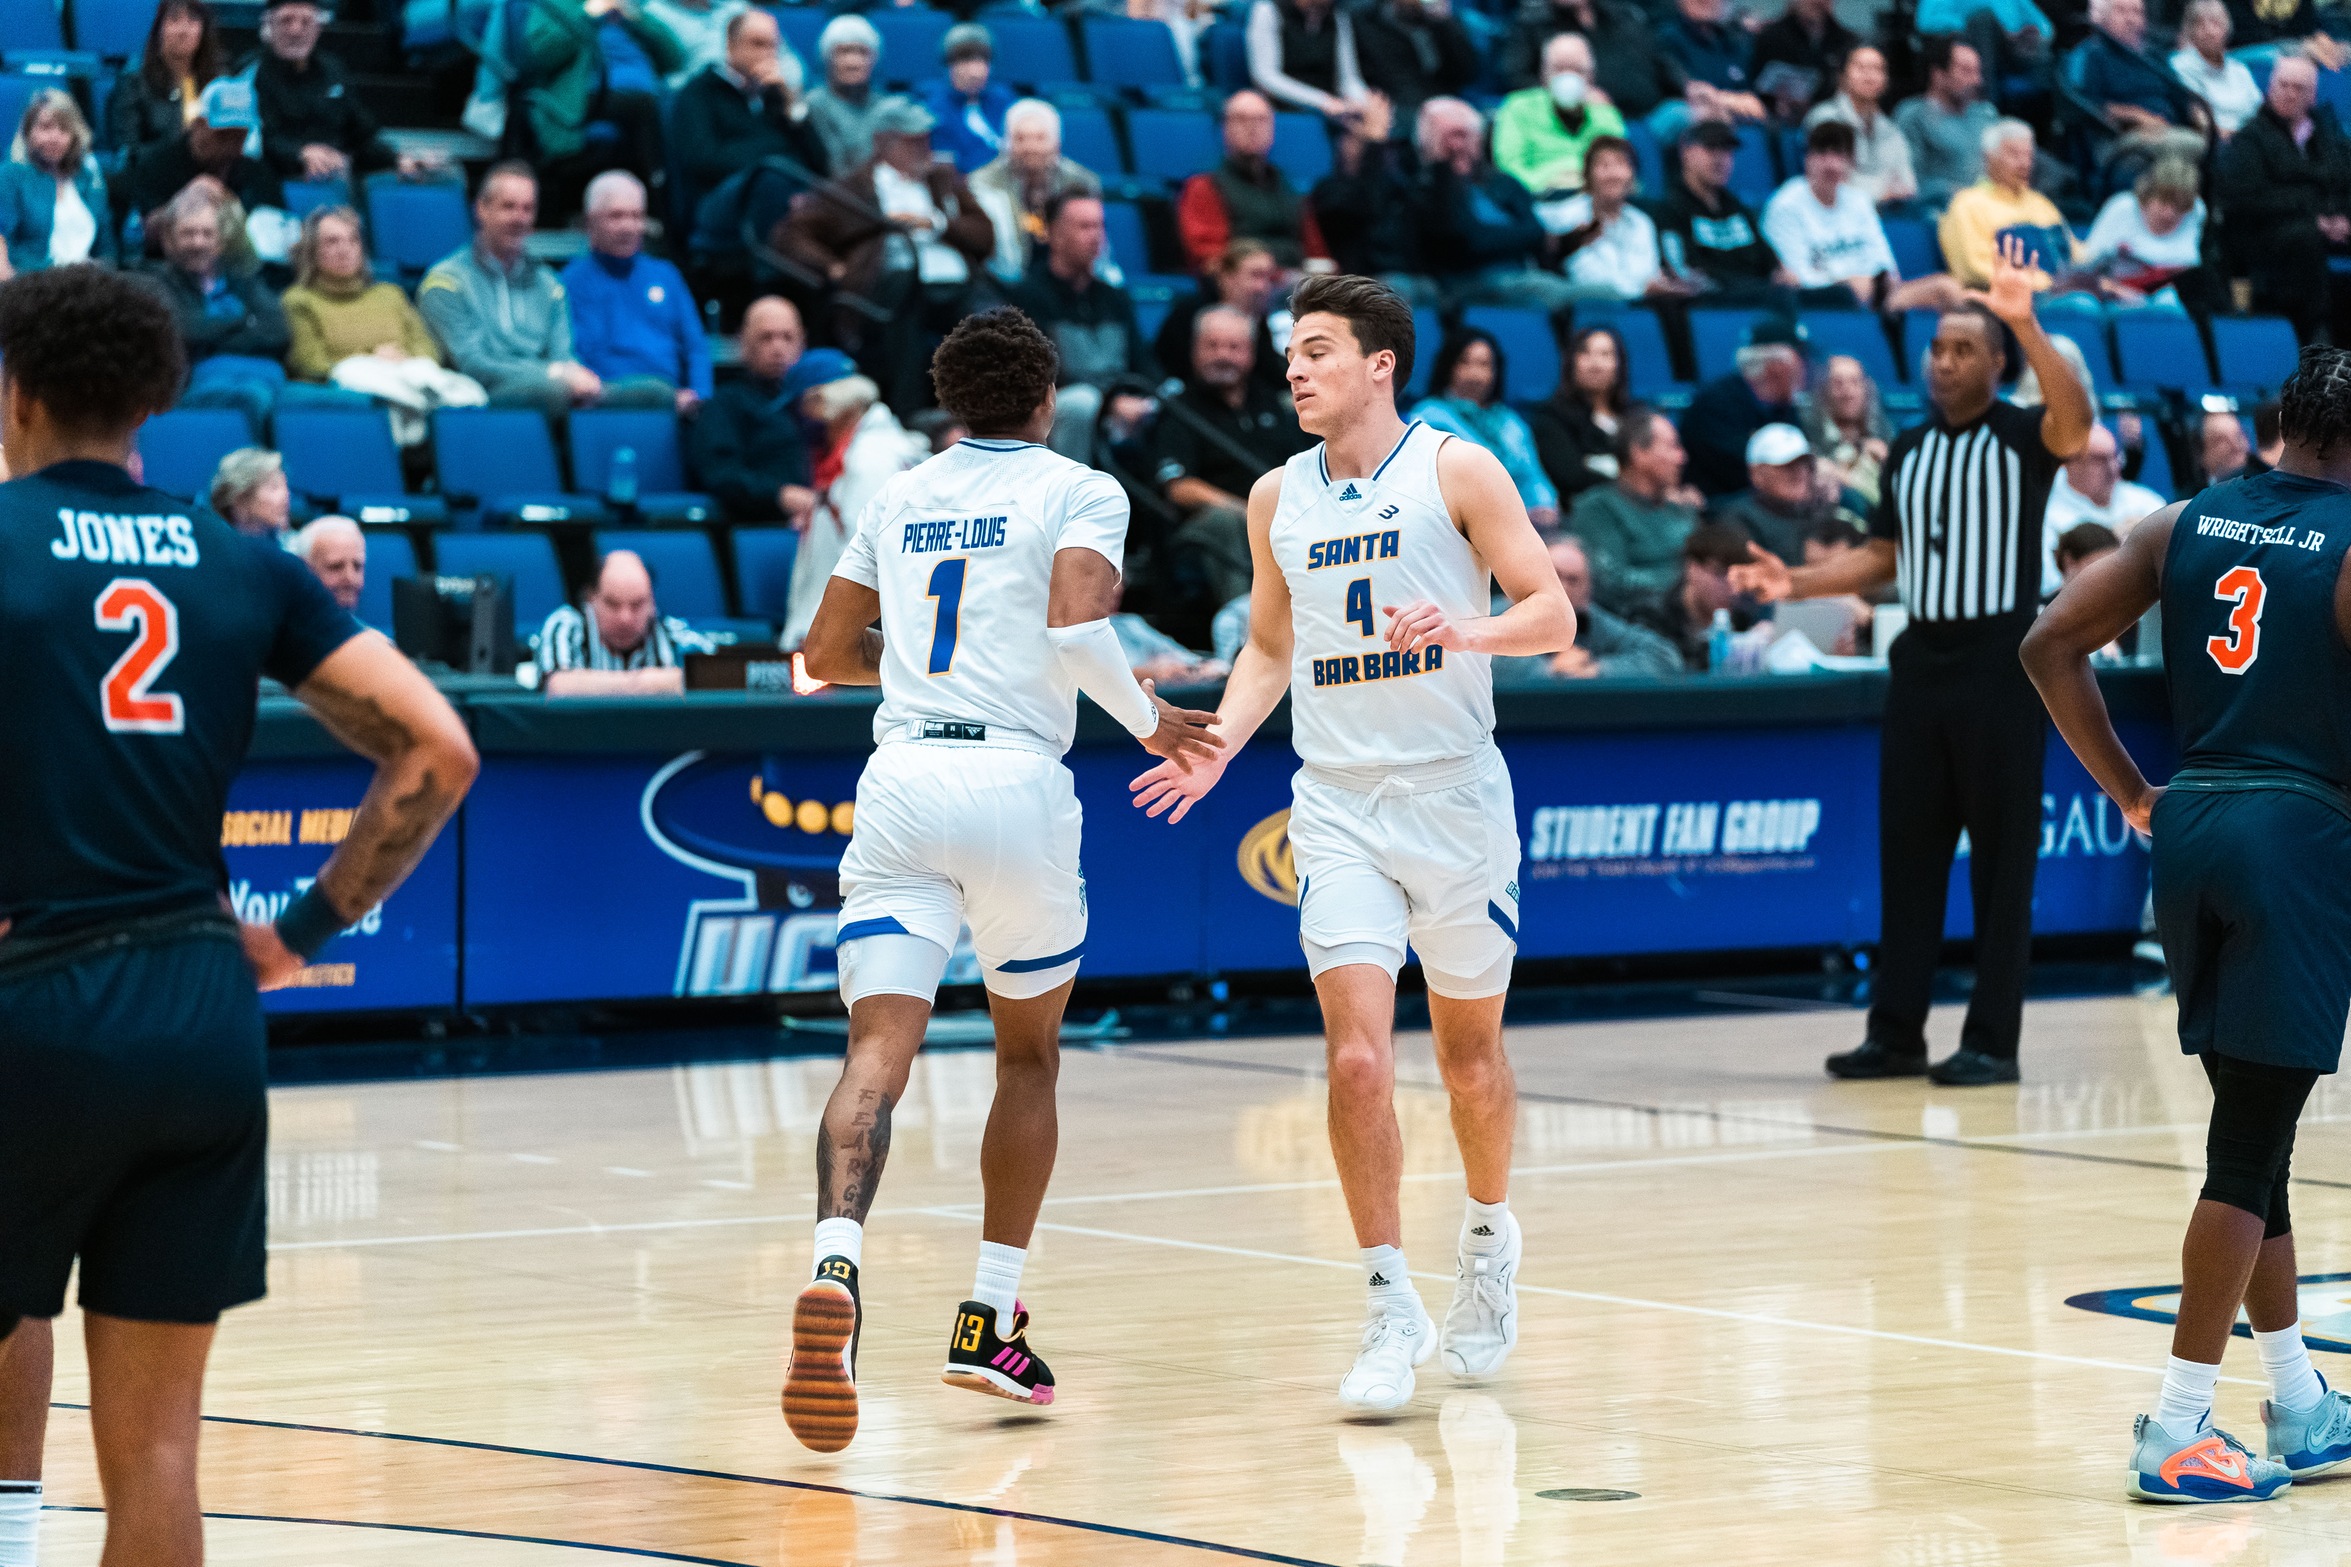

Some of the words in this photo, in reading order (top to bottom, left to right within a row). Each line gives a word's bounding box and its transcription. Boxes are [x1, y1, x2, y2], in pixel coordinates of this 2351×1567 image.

[51, 507, 199, 568] JONES
[902, 516, 1008, 554] PIERRE-LOUIS
[1307, 529, 1400, 572] SANTA
[2298, 530, 2325, 552] JR
[925, 555, 970, 678] 1
[1344, 576, 1377, 639] 4
[2206, 565, 2267, 675] 3
[94, 577, 185, 735] 2
[1313, 643, 1444, 688] BARBARA
[299, 808, 361, 844] MEDI
[1529, 803, 1660, 861] STUDENT
[1660, 802, 1720, 856] FAN
[1721, 798, 1821, 853] GROUP
[953, 1312, 985, 1352] 13
